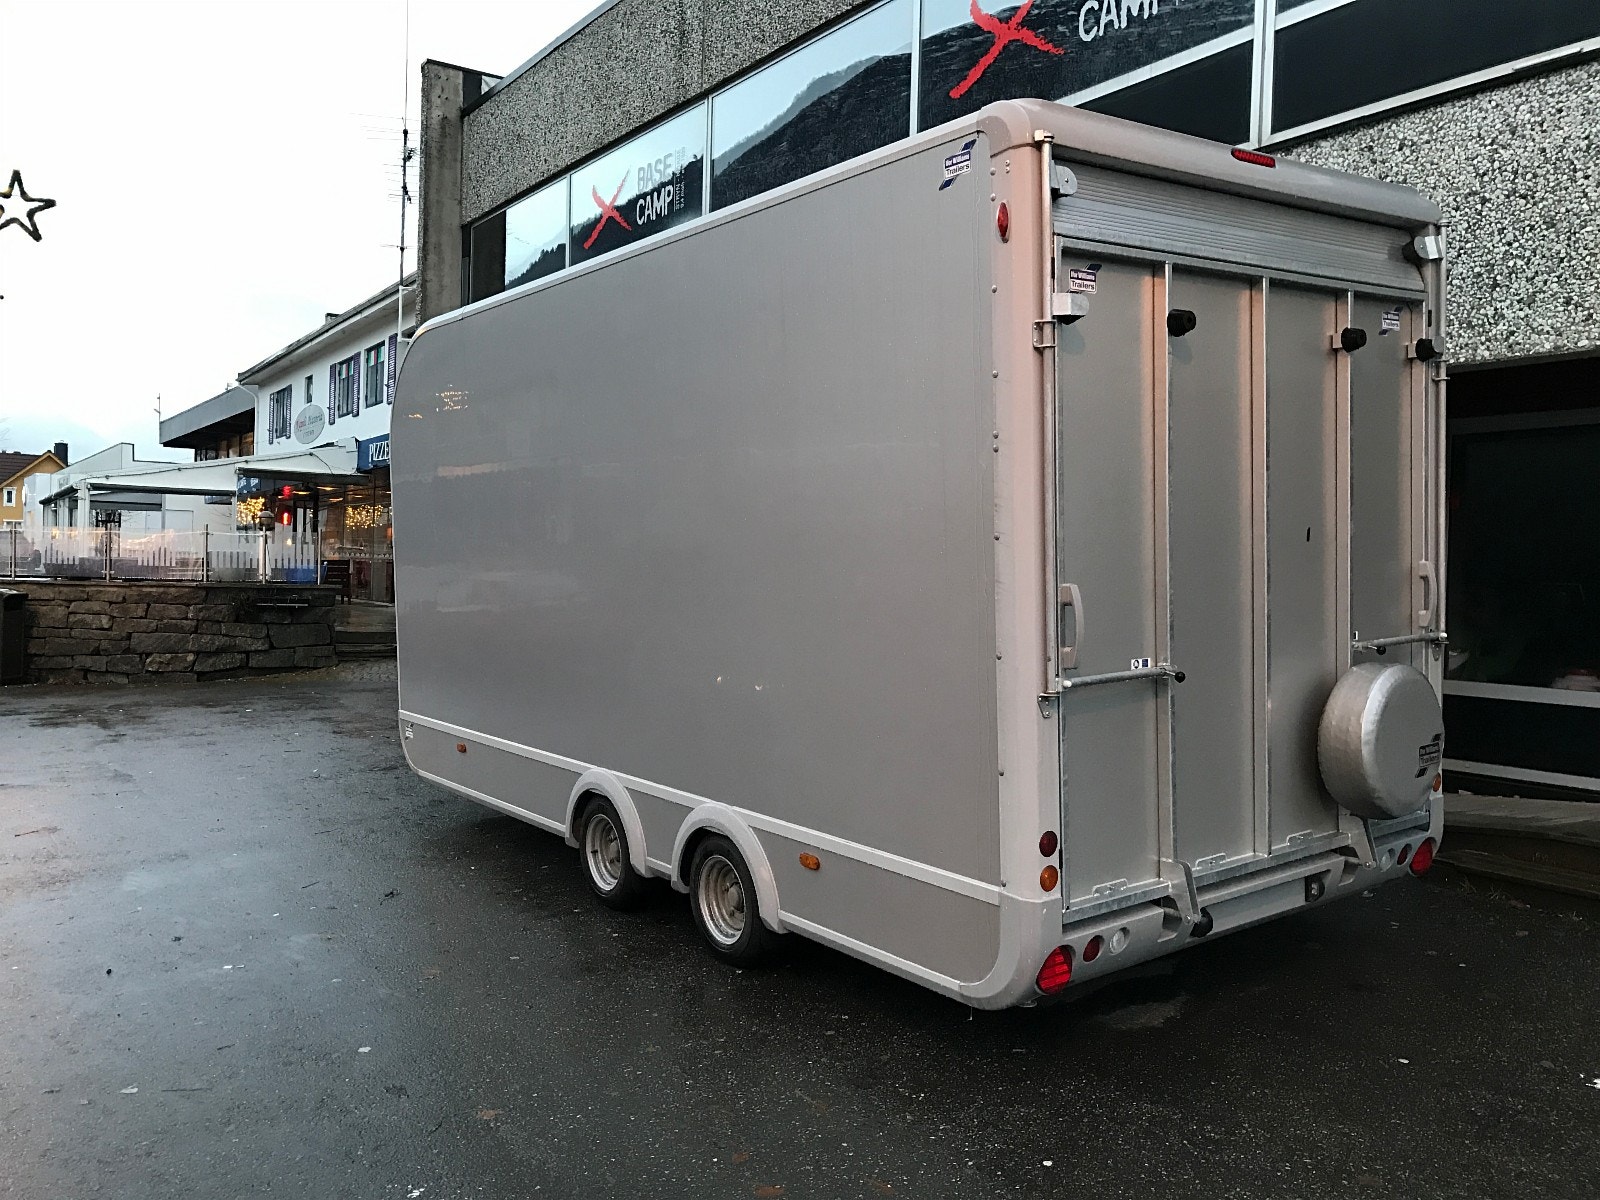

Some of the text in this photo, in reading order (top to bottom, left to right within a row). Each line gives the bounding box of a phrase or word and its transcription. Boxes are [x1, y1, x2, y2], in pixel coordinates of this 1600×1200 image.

[637, 152, 673, 195] BASE
[945, 163, 970, 176] Trailers
[636, 184, 674, 225] CAMP
[1071, 280, 1095, 291] Trailers
